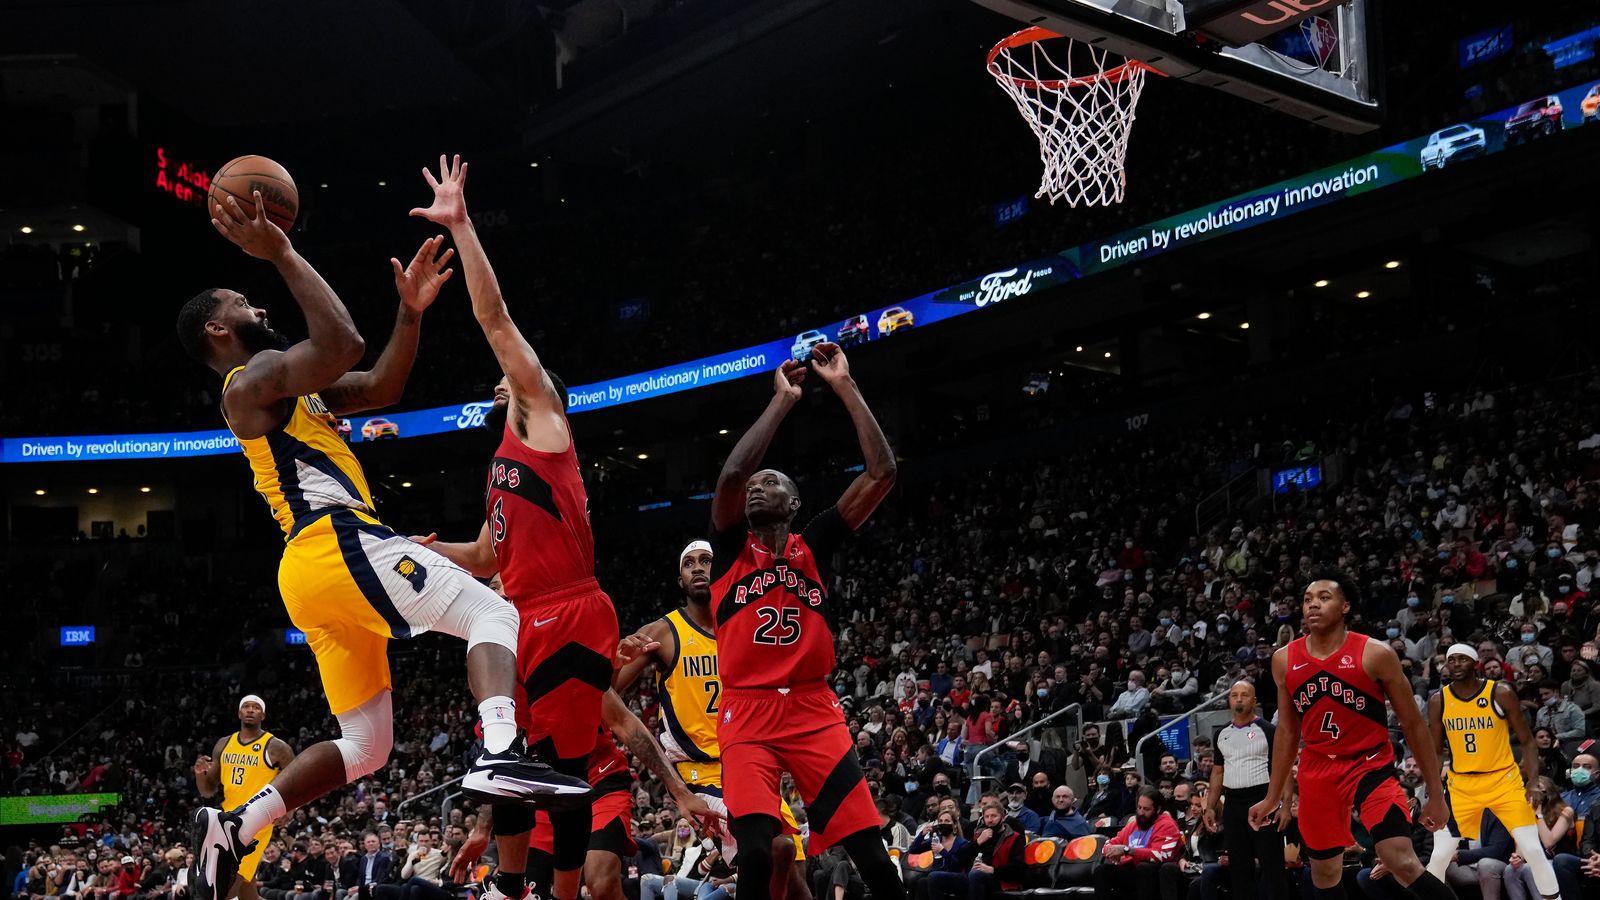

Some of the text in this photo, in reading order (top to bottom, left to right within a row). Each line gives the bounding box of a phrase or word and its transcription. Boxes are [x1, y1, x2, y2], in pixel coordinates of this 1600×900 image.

[1100, 164, 1379, 263] Driven by revolutionary innovation
[975, 267, 1033, 307] Ford
[568, 353, 766, 407] Driven by revolutionary innovation
[457, 401, 495, 429] Fo
[22, 436, 239, 457] Driven by revolutionary innovation
[734, 565, 822, 607] RAPTORS
[65, 630, 91, 642] IBM
[753, 606, 801, 646] 25
[682, 655, 718, 678] INDI
[1320, 711, 1340, 740] 4
[1444, 716, 1494, 732] INDIANA
[1464, 733, 1477, 753] 8
[223, 752, 259, 767] INDIANA
[231, 766, 245, 786] 13
